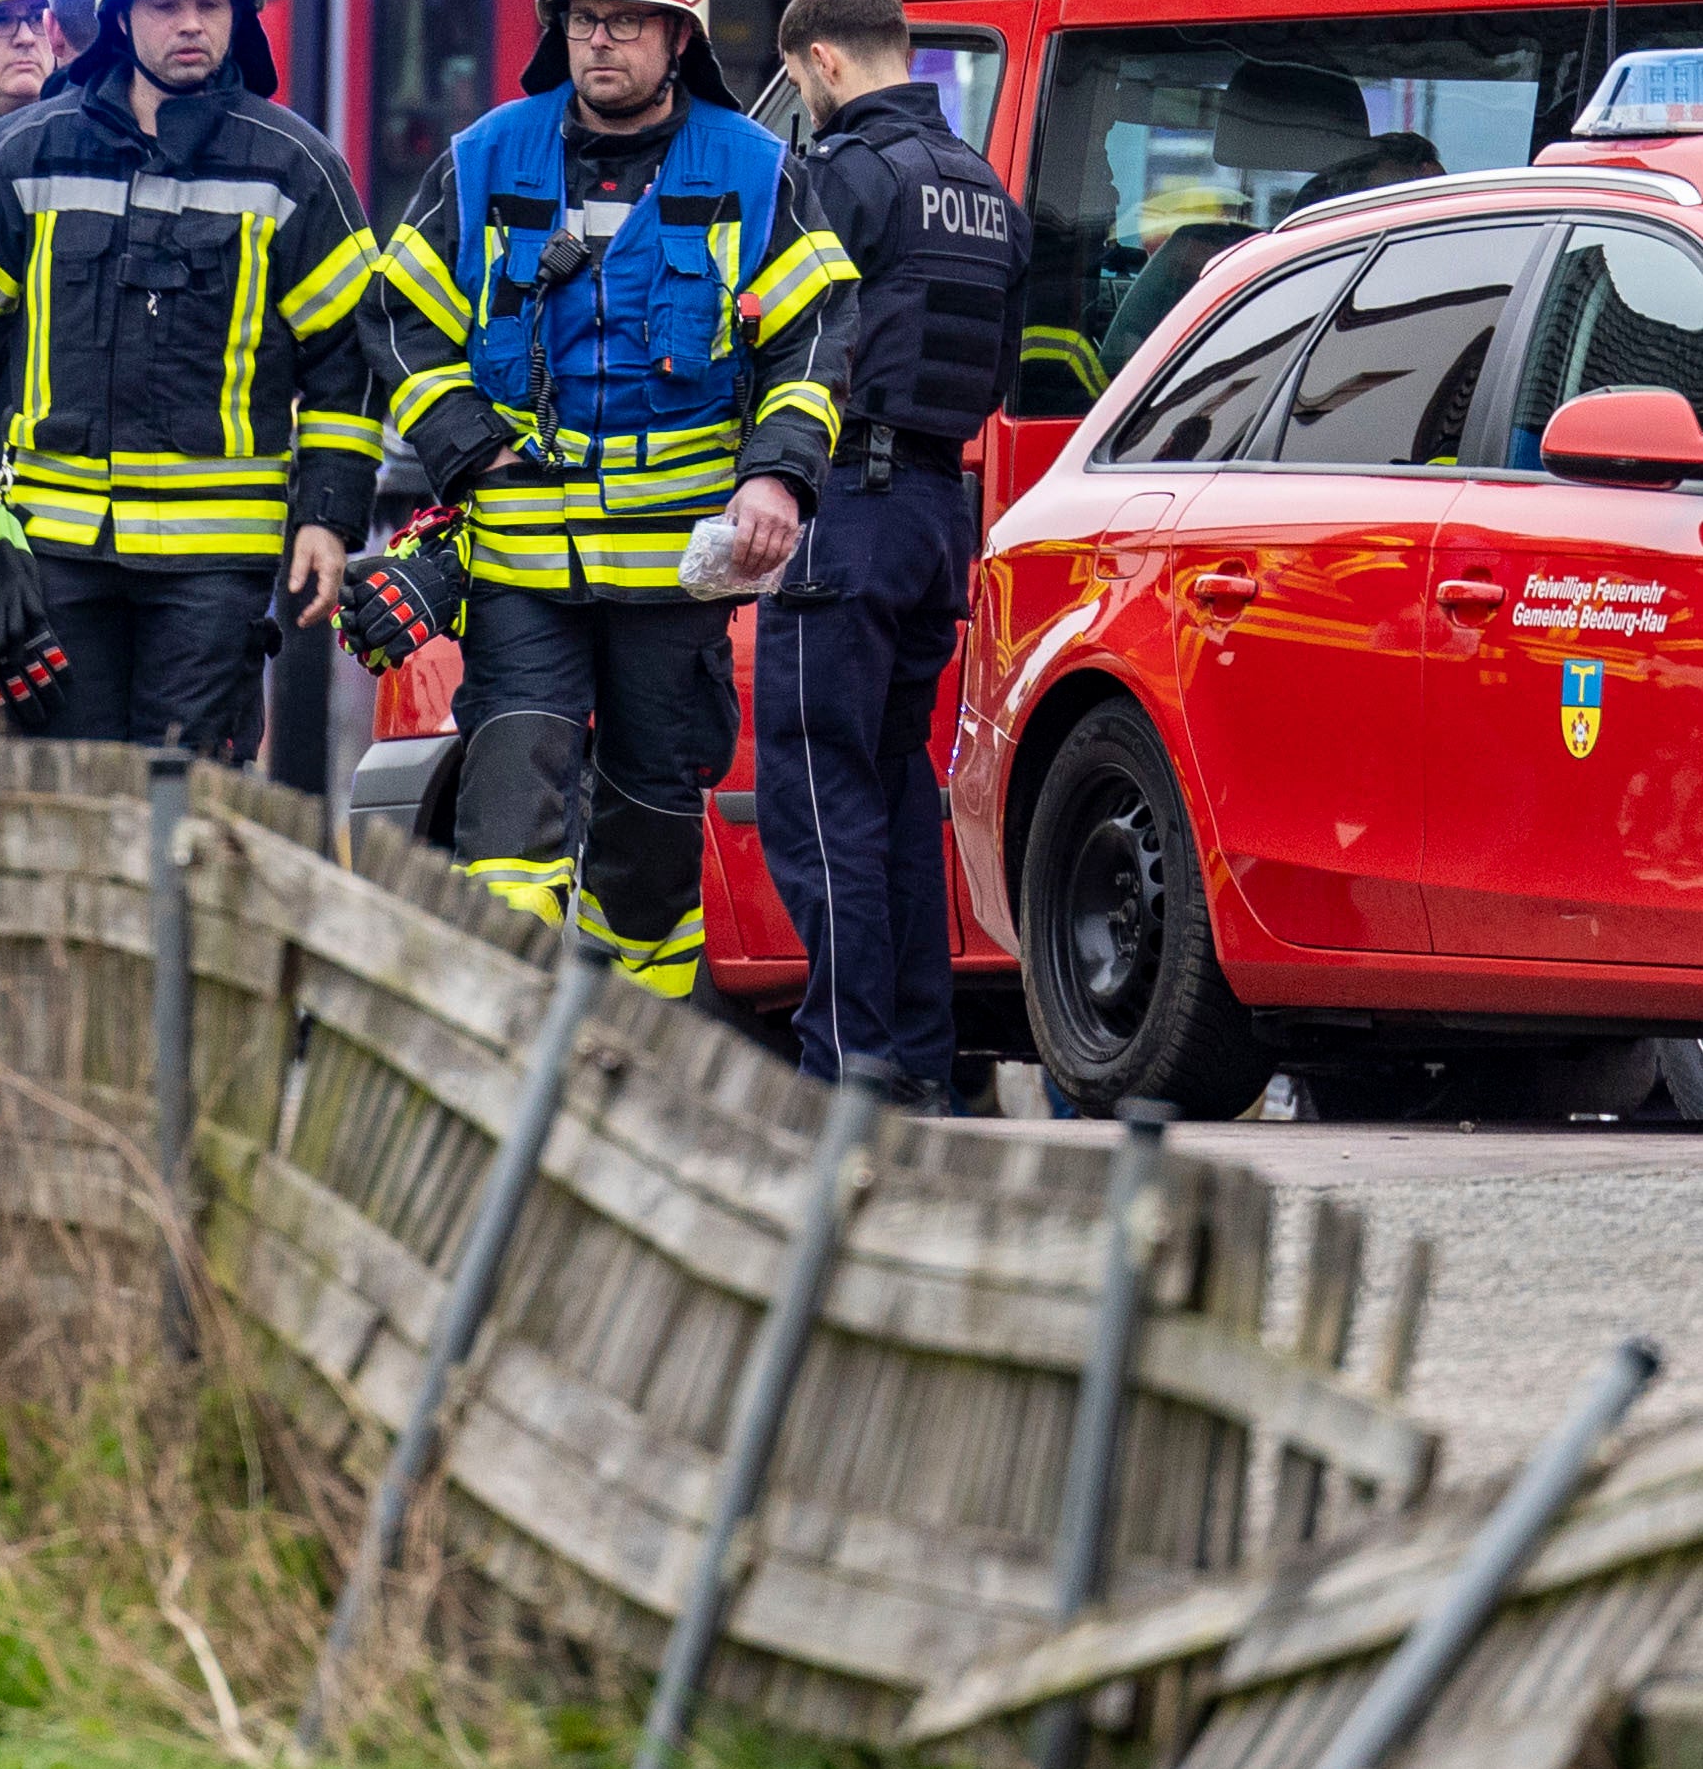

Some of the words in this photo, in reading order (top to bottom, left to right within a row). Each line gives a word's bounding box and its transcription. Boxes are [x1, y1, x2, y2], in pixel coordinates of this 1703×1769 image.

[921, 184, 1009, 243] POLIZEI
[1523, 574, 1592, 605] Freiwillige
[1594, 577, 1667, 604] Feuerwehr
[1512, 602, 1578, 628] Gemeinde
[1579, 605, 1669, 637] Bedburg-Hau
